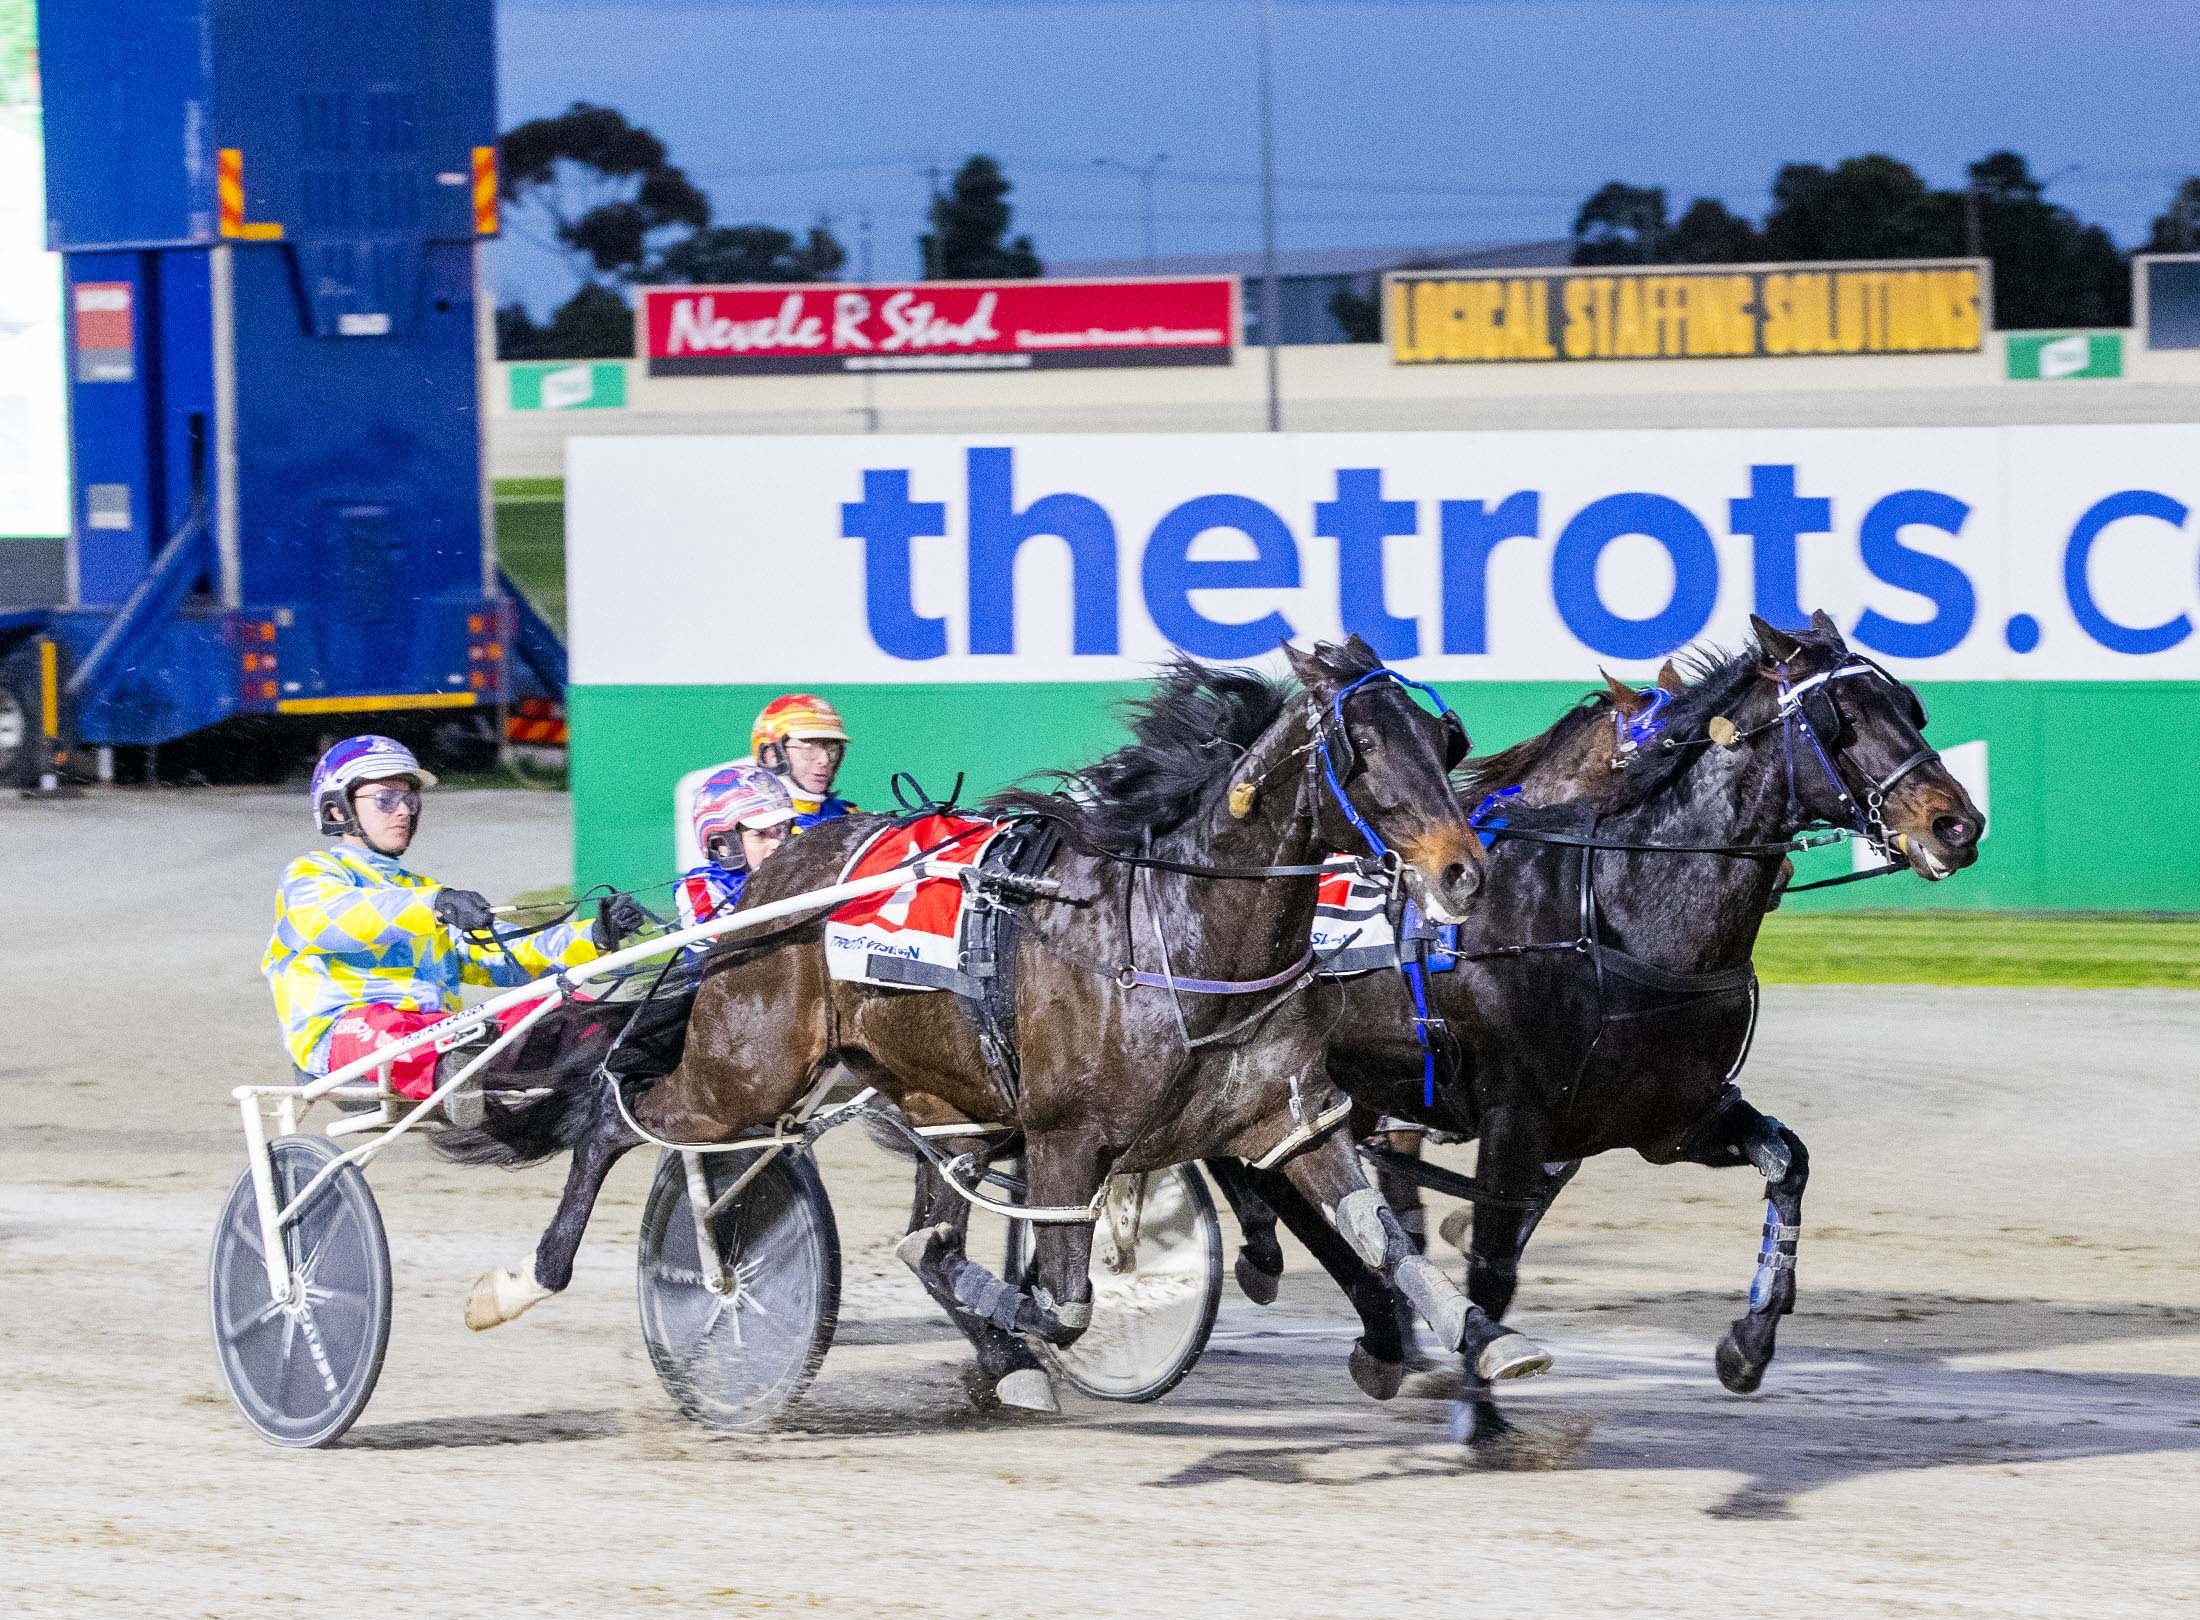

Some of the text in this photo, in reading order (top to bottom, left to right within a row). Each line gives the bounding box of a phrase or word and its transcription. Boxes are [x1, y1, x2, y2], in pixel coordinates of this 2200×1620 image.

[832, 292, 873, 350] R
[880, 290, 1000, 350] Stud
[1563, 274, 1754, 358] STAFFING
[1764, 270, 1980, 353] SOLUTIONS
[840, 446, 2200, 661] thetrots.c
